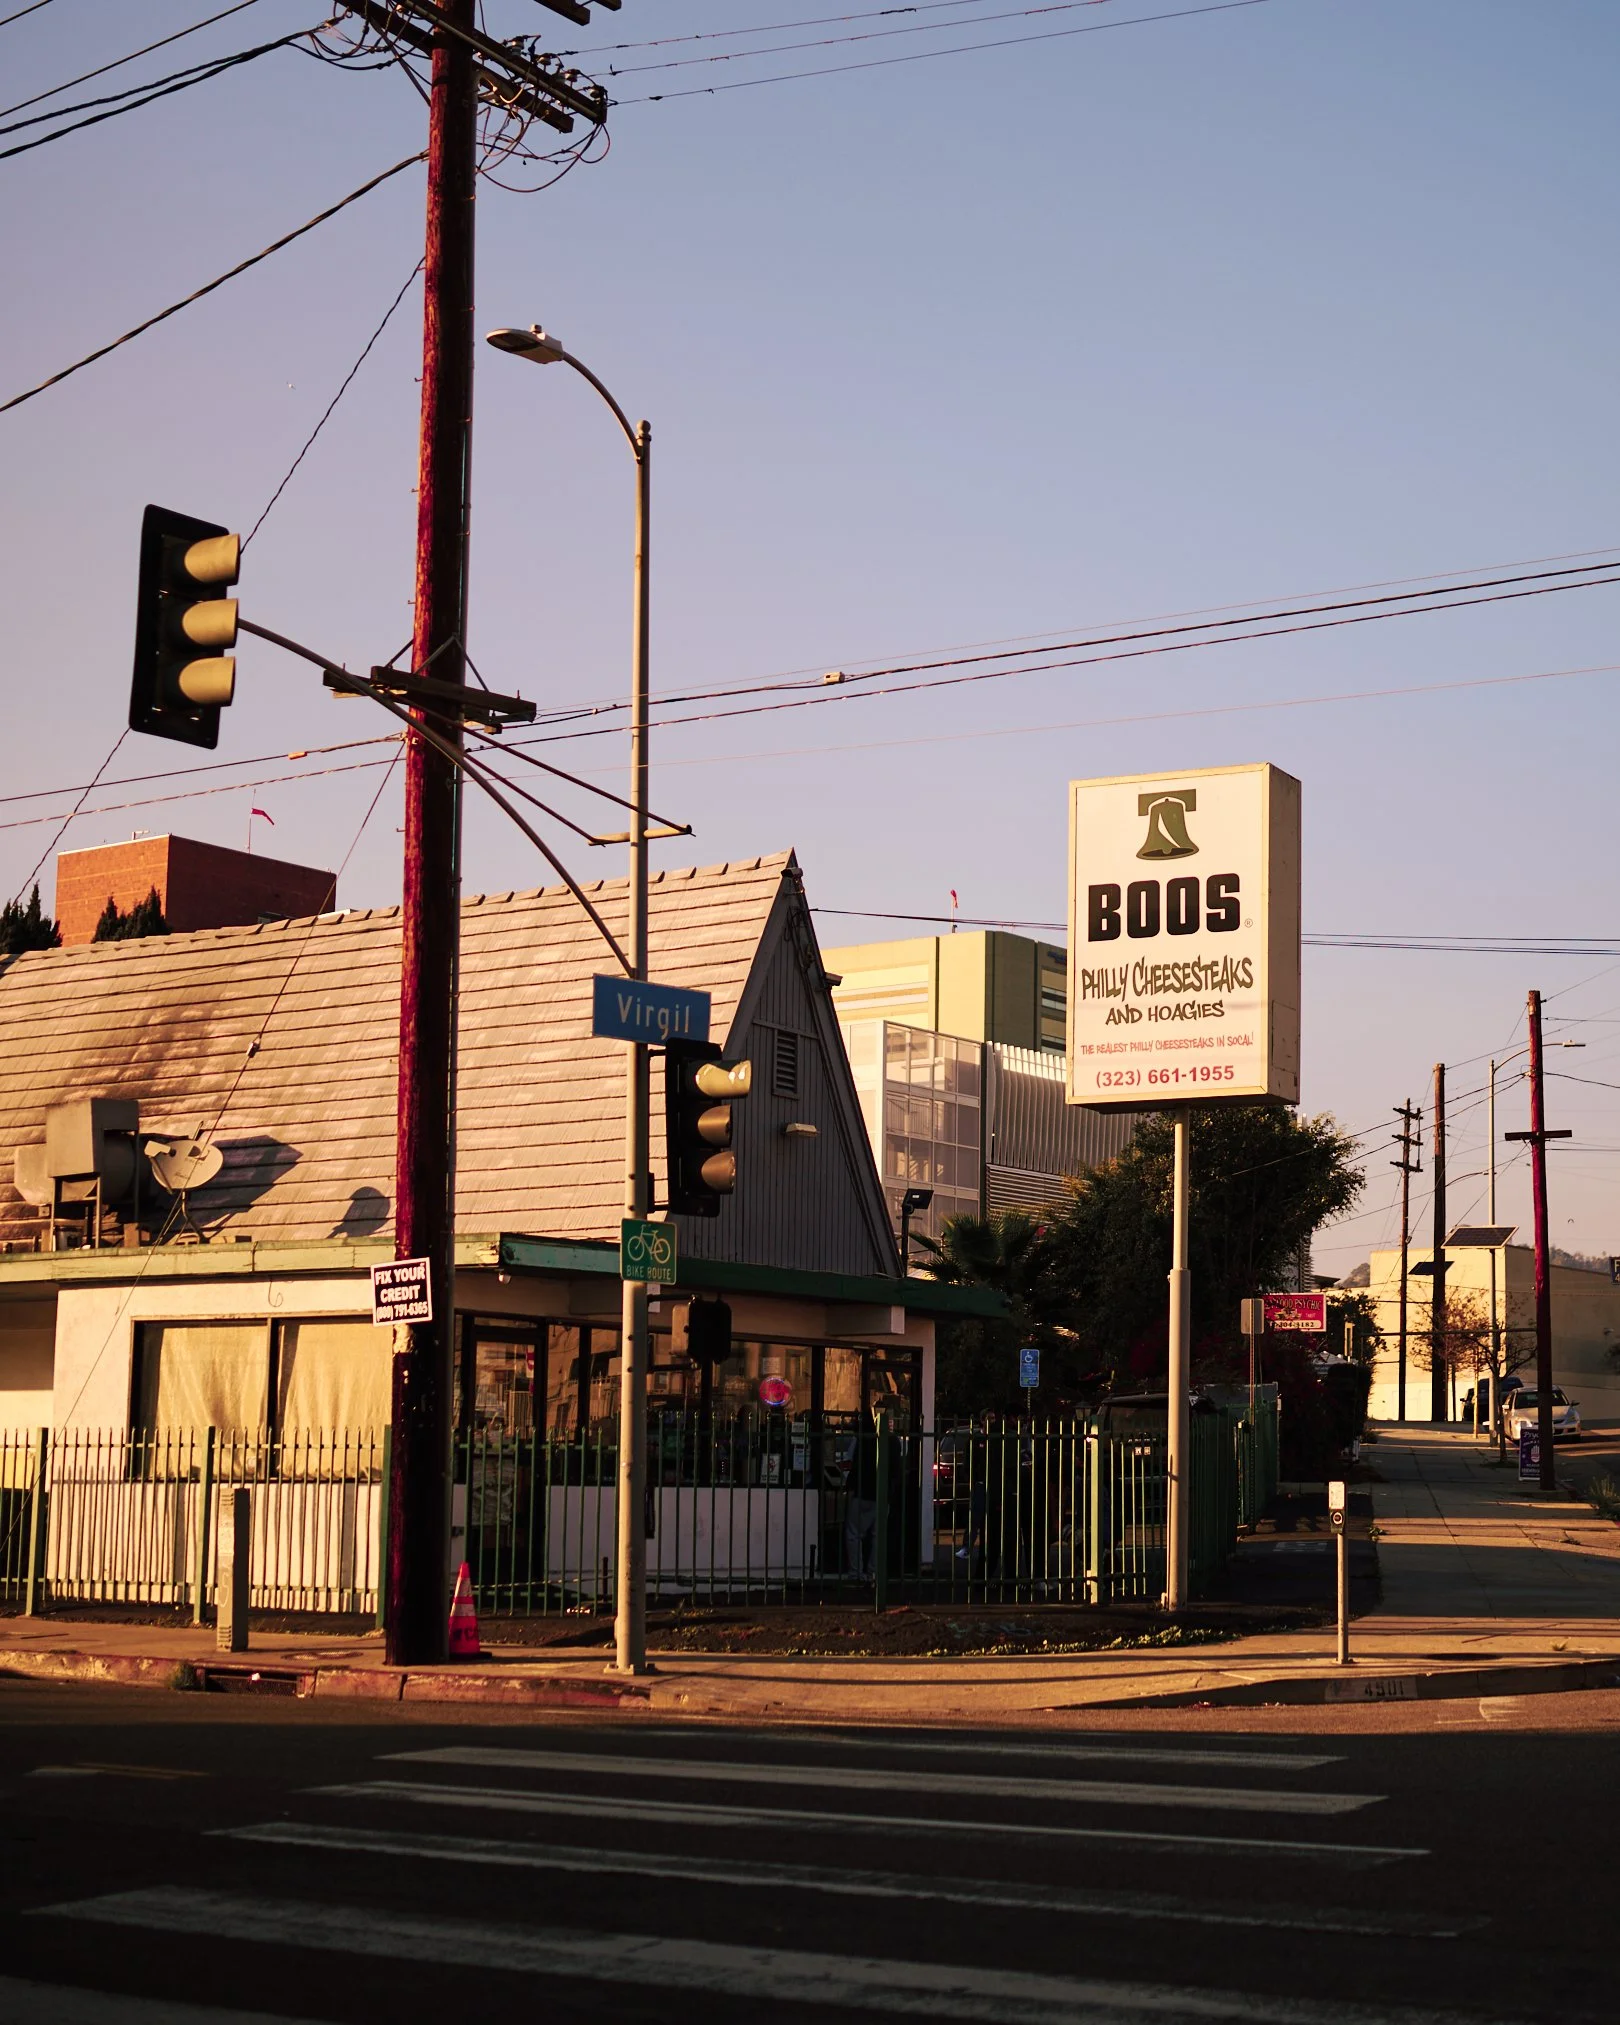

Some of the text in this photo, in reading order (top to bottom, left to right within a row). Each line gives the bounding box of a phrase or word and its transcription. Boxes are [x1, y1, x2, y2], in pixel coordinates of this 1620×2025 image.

[1088, 873, 1240, 942] BOOS
[1082, 955, 1254, 1002] PHILLY CHEESESTEAKS
[617, 992, 690, 1041] Virgil
[1105, 1000, 1225, 1025] AND HOAGIES
[1081, 1045, 1095, 1055] THE
[1096, 1041, 1128, 1054] REALEST
[1130, 1039, 1153, 1053] PHILLY
[1155, 1036, 1215, 1051] CHEESESTEAKS
[1217, 1035, 1225, 1047] IN
[1096, 1065, 1235, 1088] (323) 661-1955
[375, 1266, 426, 1285] FIX YOUR
[626, 1264, 671, 1281] BIKE ROUTE
[380, 1285, 421, 1303] CREDIT
